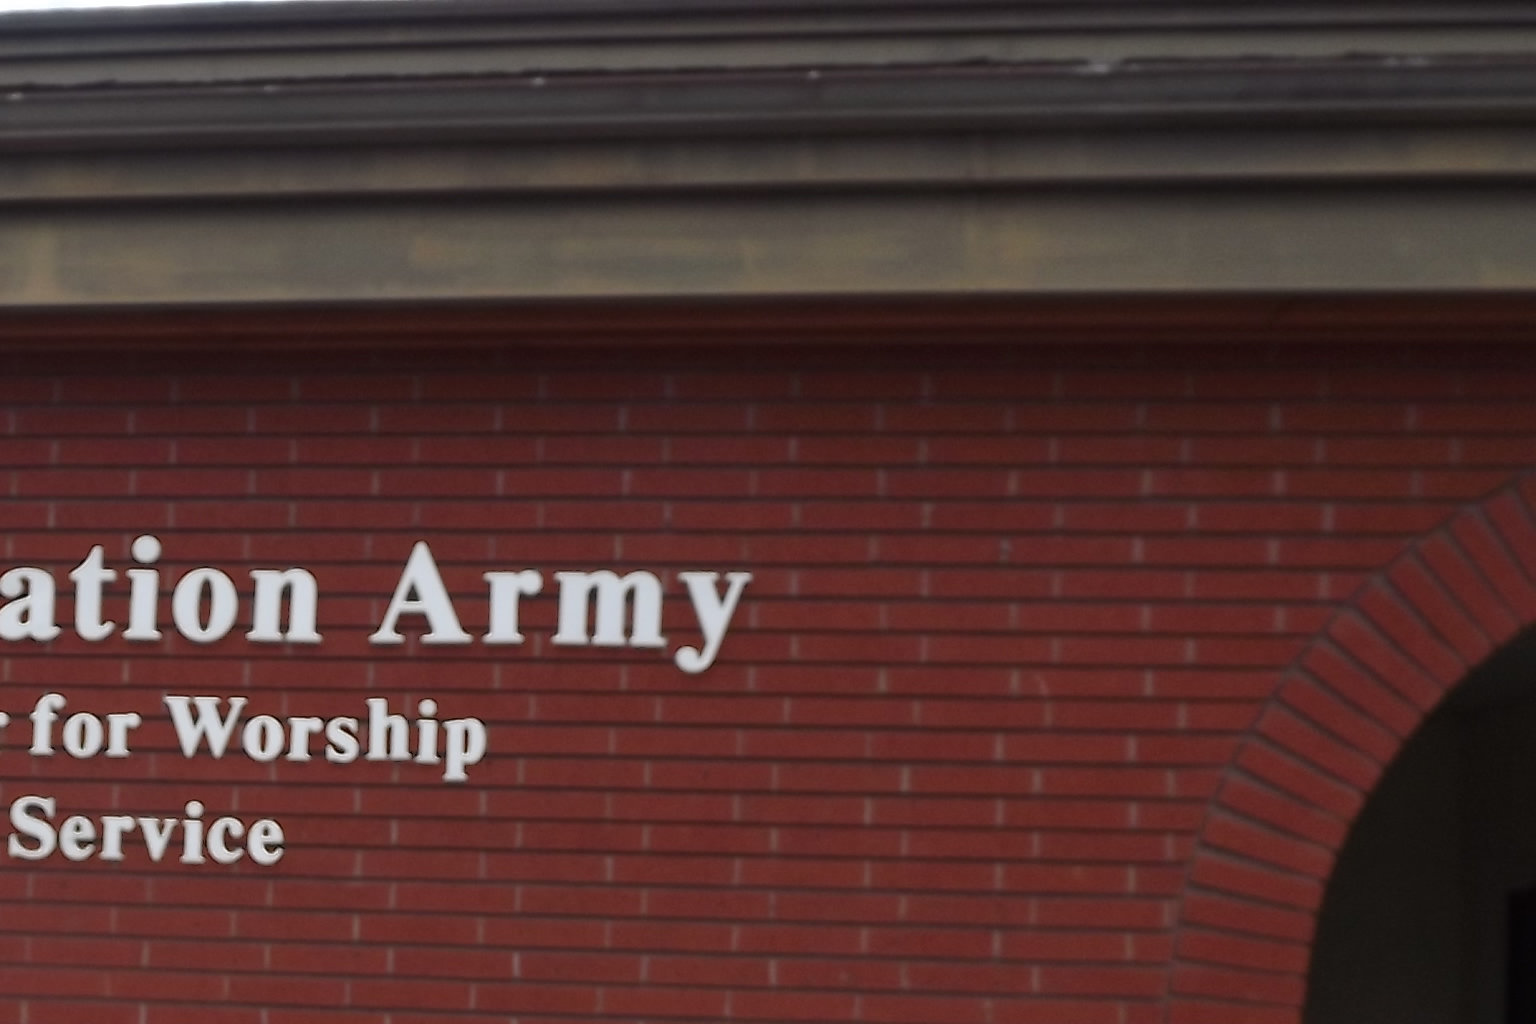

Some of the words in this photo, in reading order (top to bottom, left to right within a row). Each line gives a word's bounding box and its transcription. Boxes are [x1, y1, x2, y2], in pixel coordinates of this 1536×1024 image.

[369, 541, 753, 673] Army
[29, 693, 141, 758] for
[164, 695, 487, 781] Worship
[8, 795, 285, 865] Service
